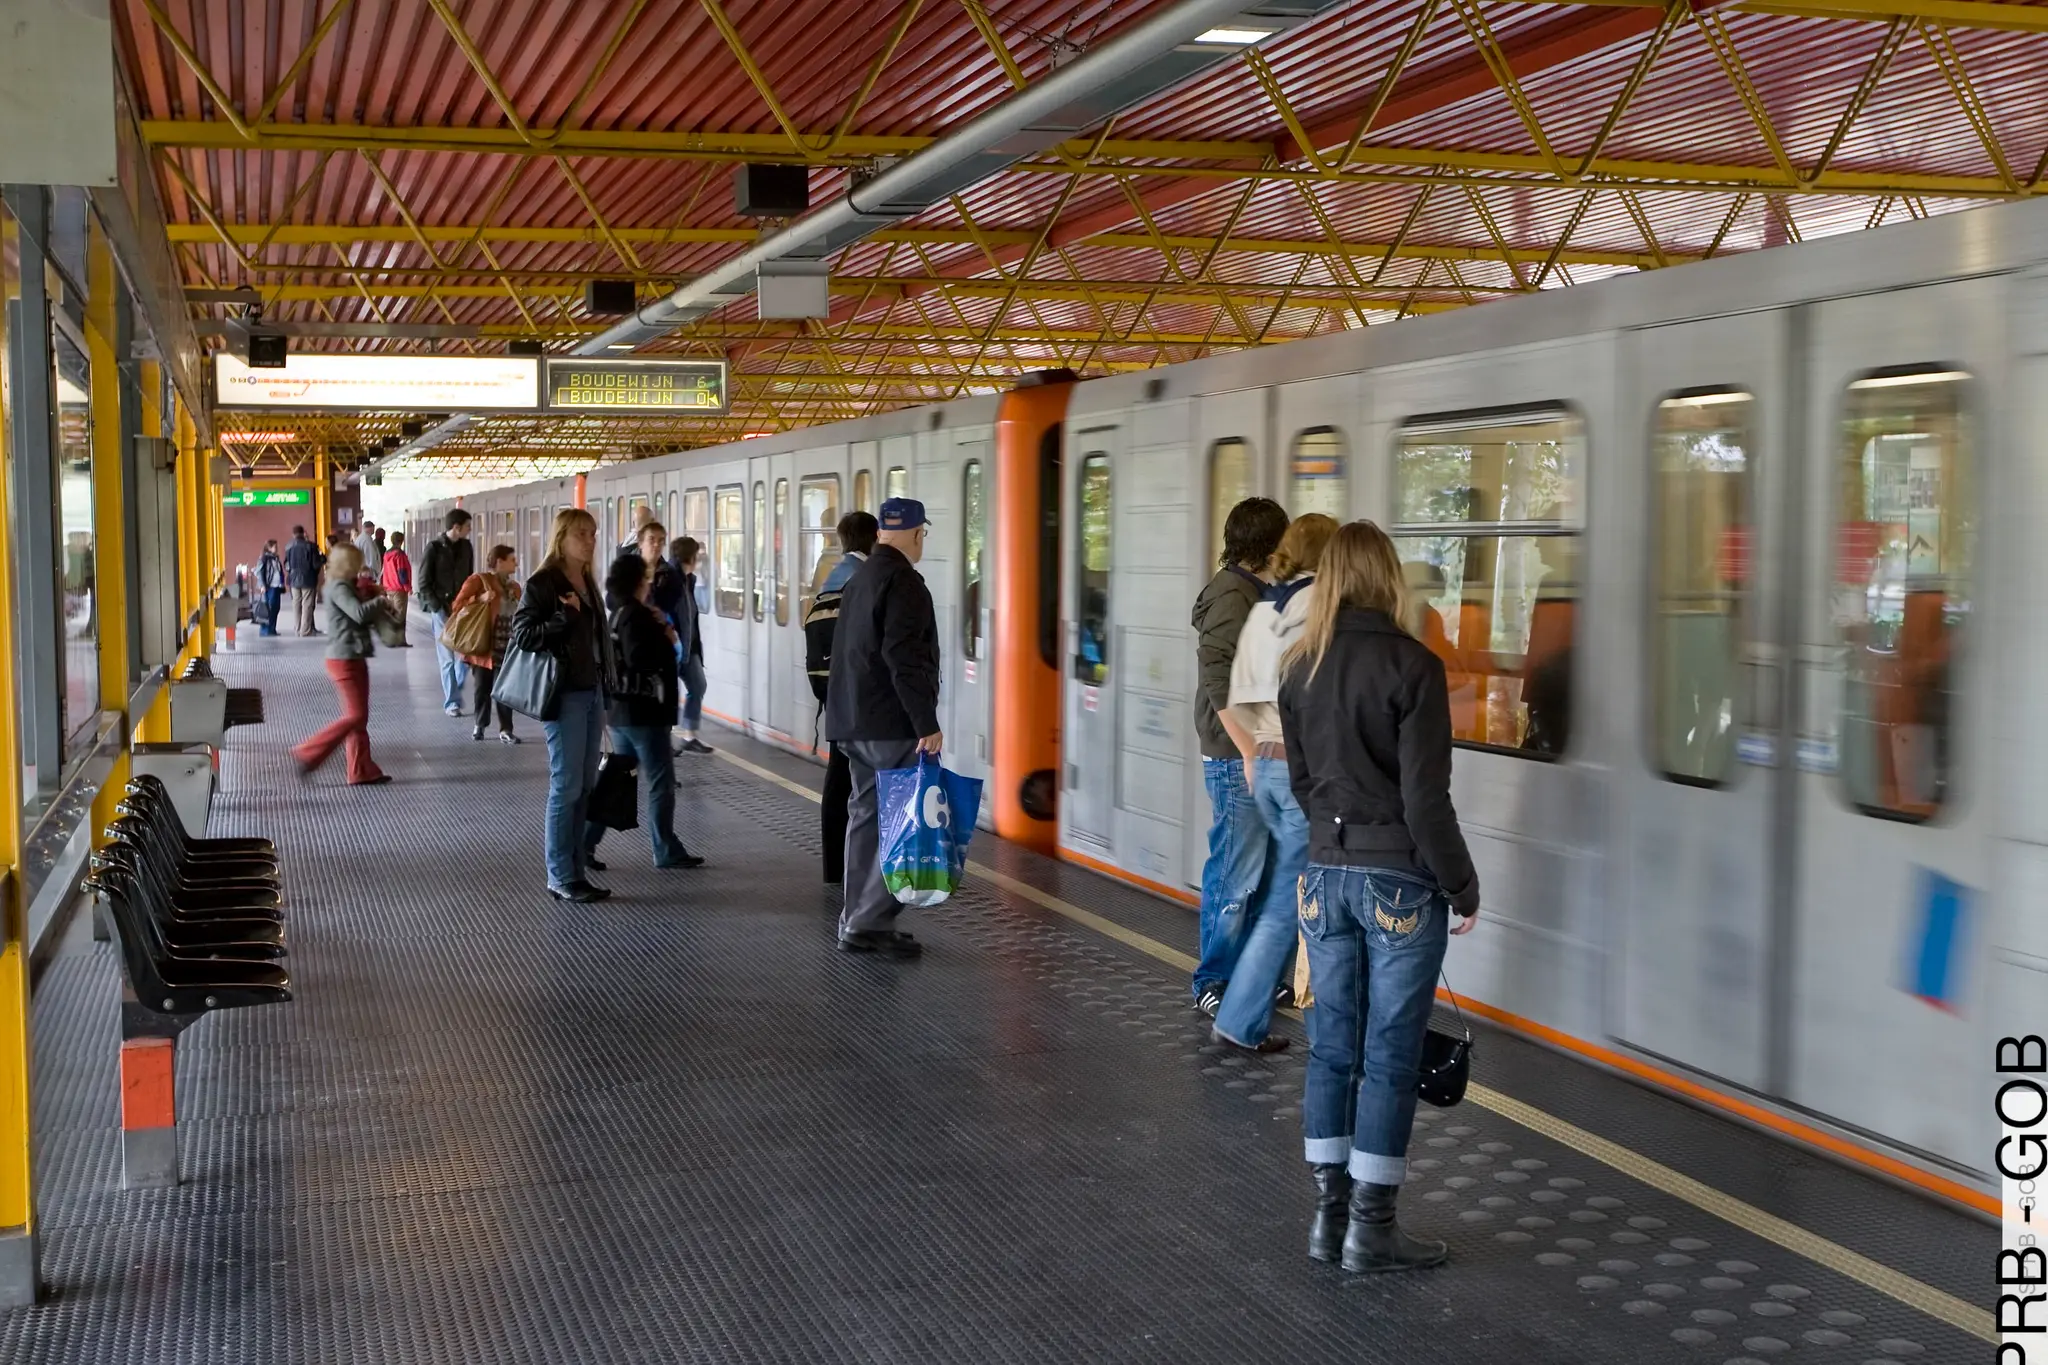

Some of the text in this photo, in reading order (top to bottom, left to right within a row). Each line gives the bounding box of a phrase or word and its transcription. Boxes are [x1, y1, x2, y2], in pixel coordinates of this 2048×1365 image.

[570, 373, 707, 388] BOUDEWIJN 6
[570, 390, 707, 405] BOUDEWIJN 0
